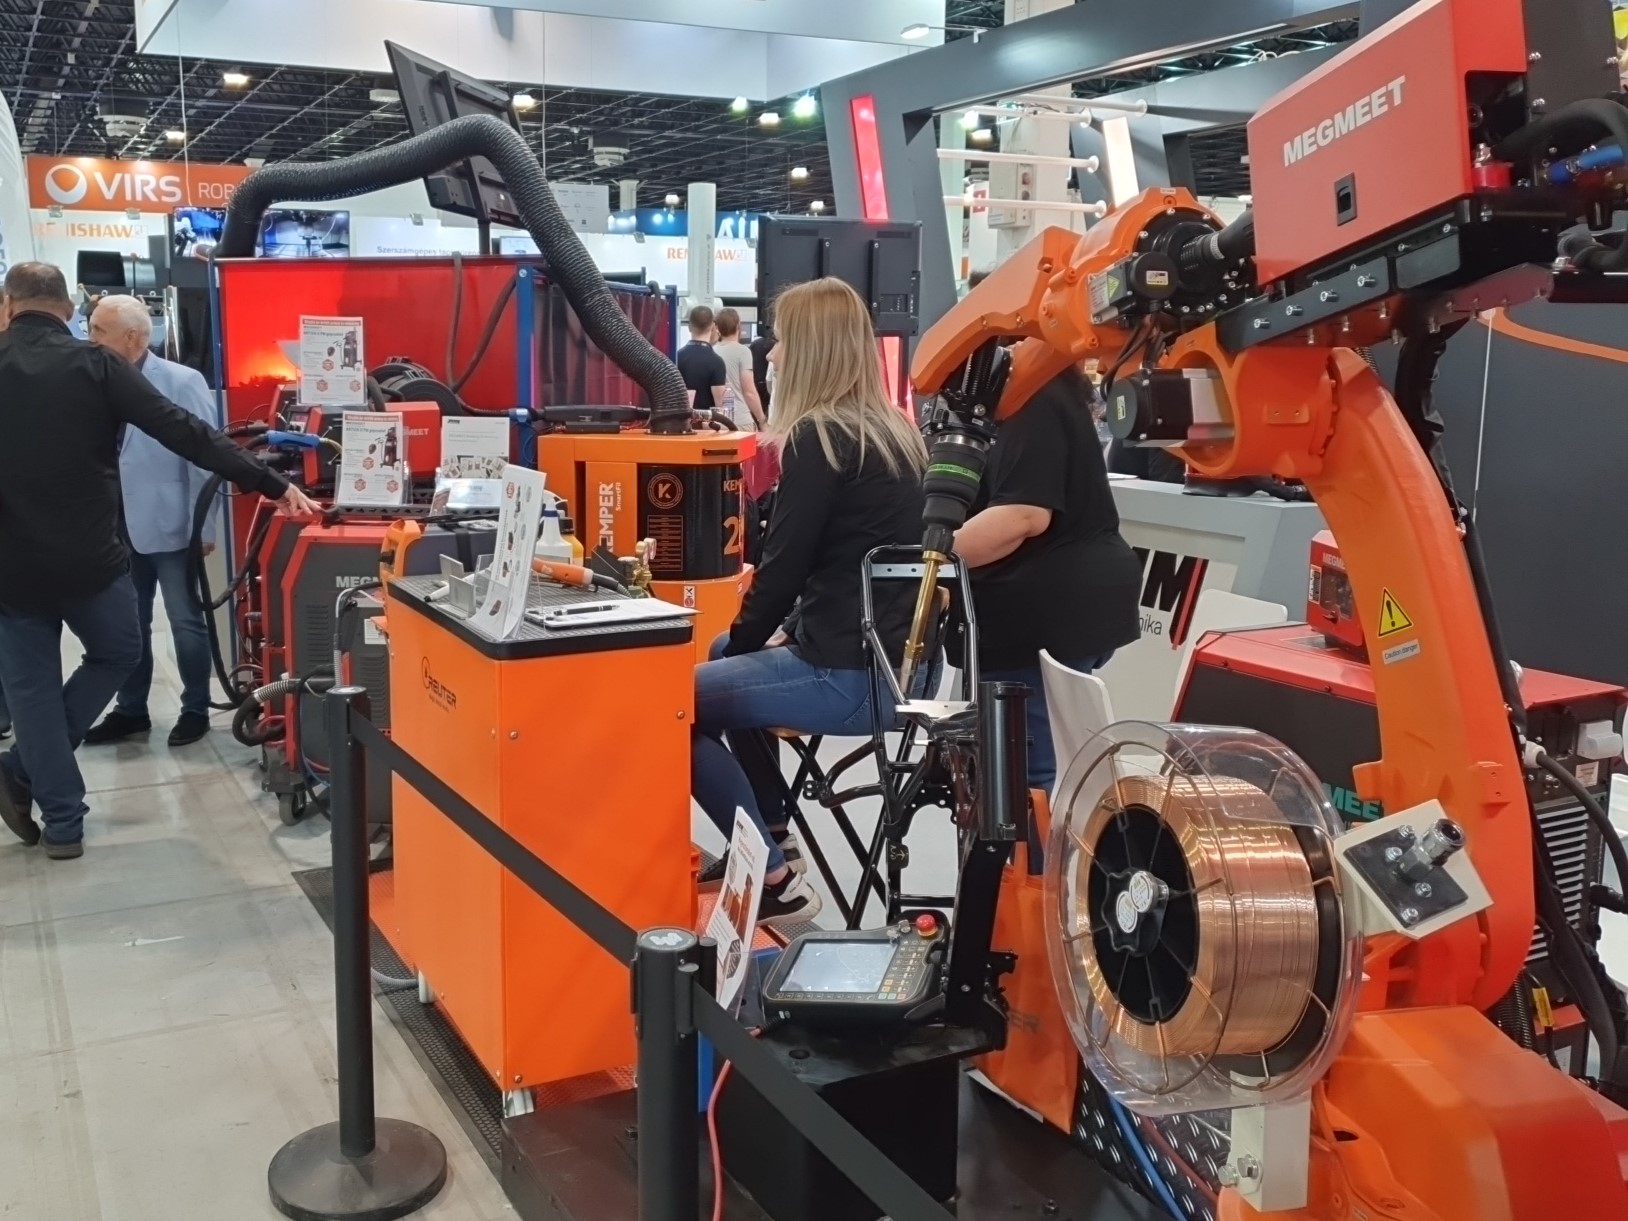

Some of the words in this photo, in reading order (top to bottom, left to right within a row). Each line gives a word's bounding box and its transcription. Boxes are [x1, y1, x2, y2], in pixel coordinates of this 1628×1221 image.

[1283, 74, 1406, 168] MEGMEET
[93, 171, 182, 203] VIRS
[198, 182, 233, 200] ROB
[666, 247, 737, 261] REAW
[723, 479, 742, 493] KEM
[599, 482, 614, 553] EMPER
[1322, 551, 1346, 570] MEGME
[1138, 612, 1163, 636] nika
